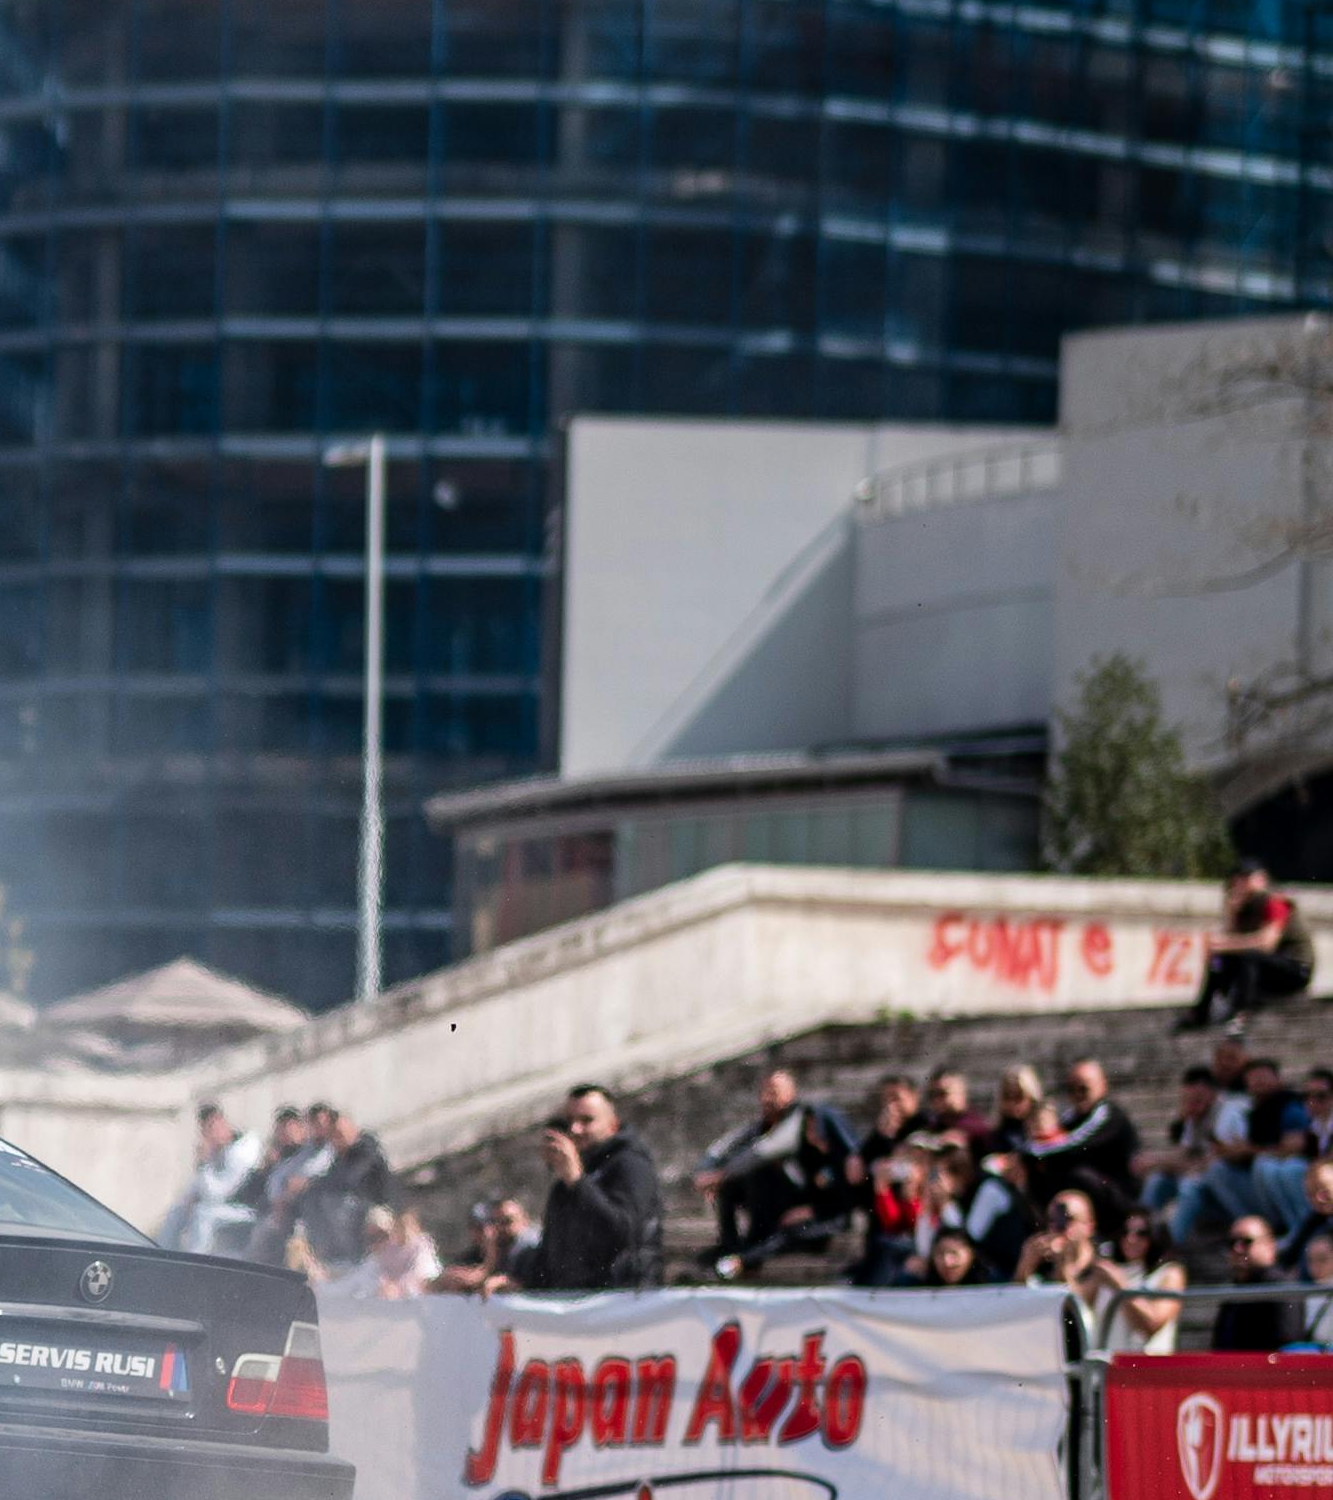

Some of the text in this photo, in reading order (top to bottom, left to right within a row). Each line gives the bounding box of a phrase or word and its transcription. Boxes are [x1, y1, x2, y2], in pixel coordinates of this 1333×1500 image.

[94, 1351, 156, 1379] RUSI
[461, 1317, 869, 1487] Japan Auto
